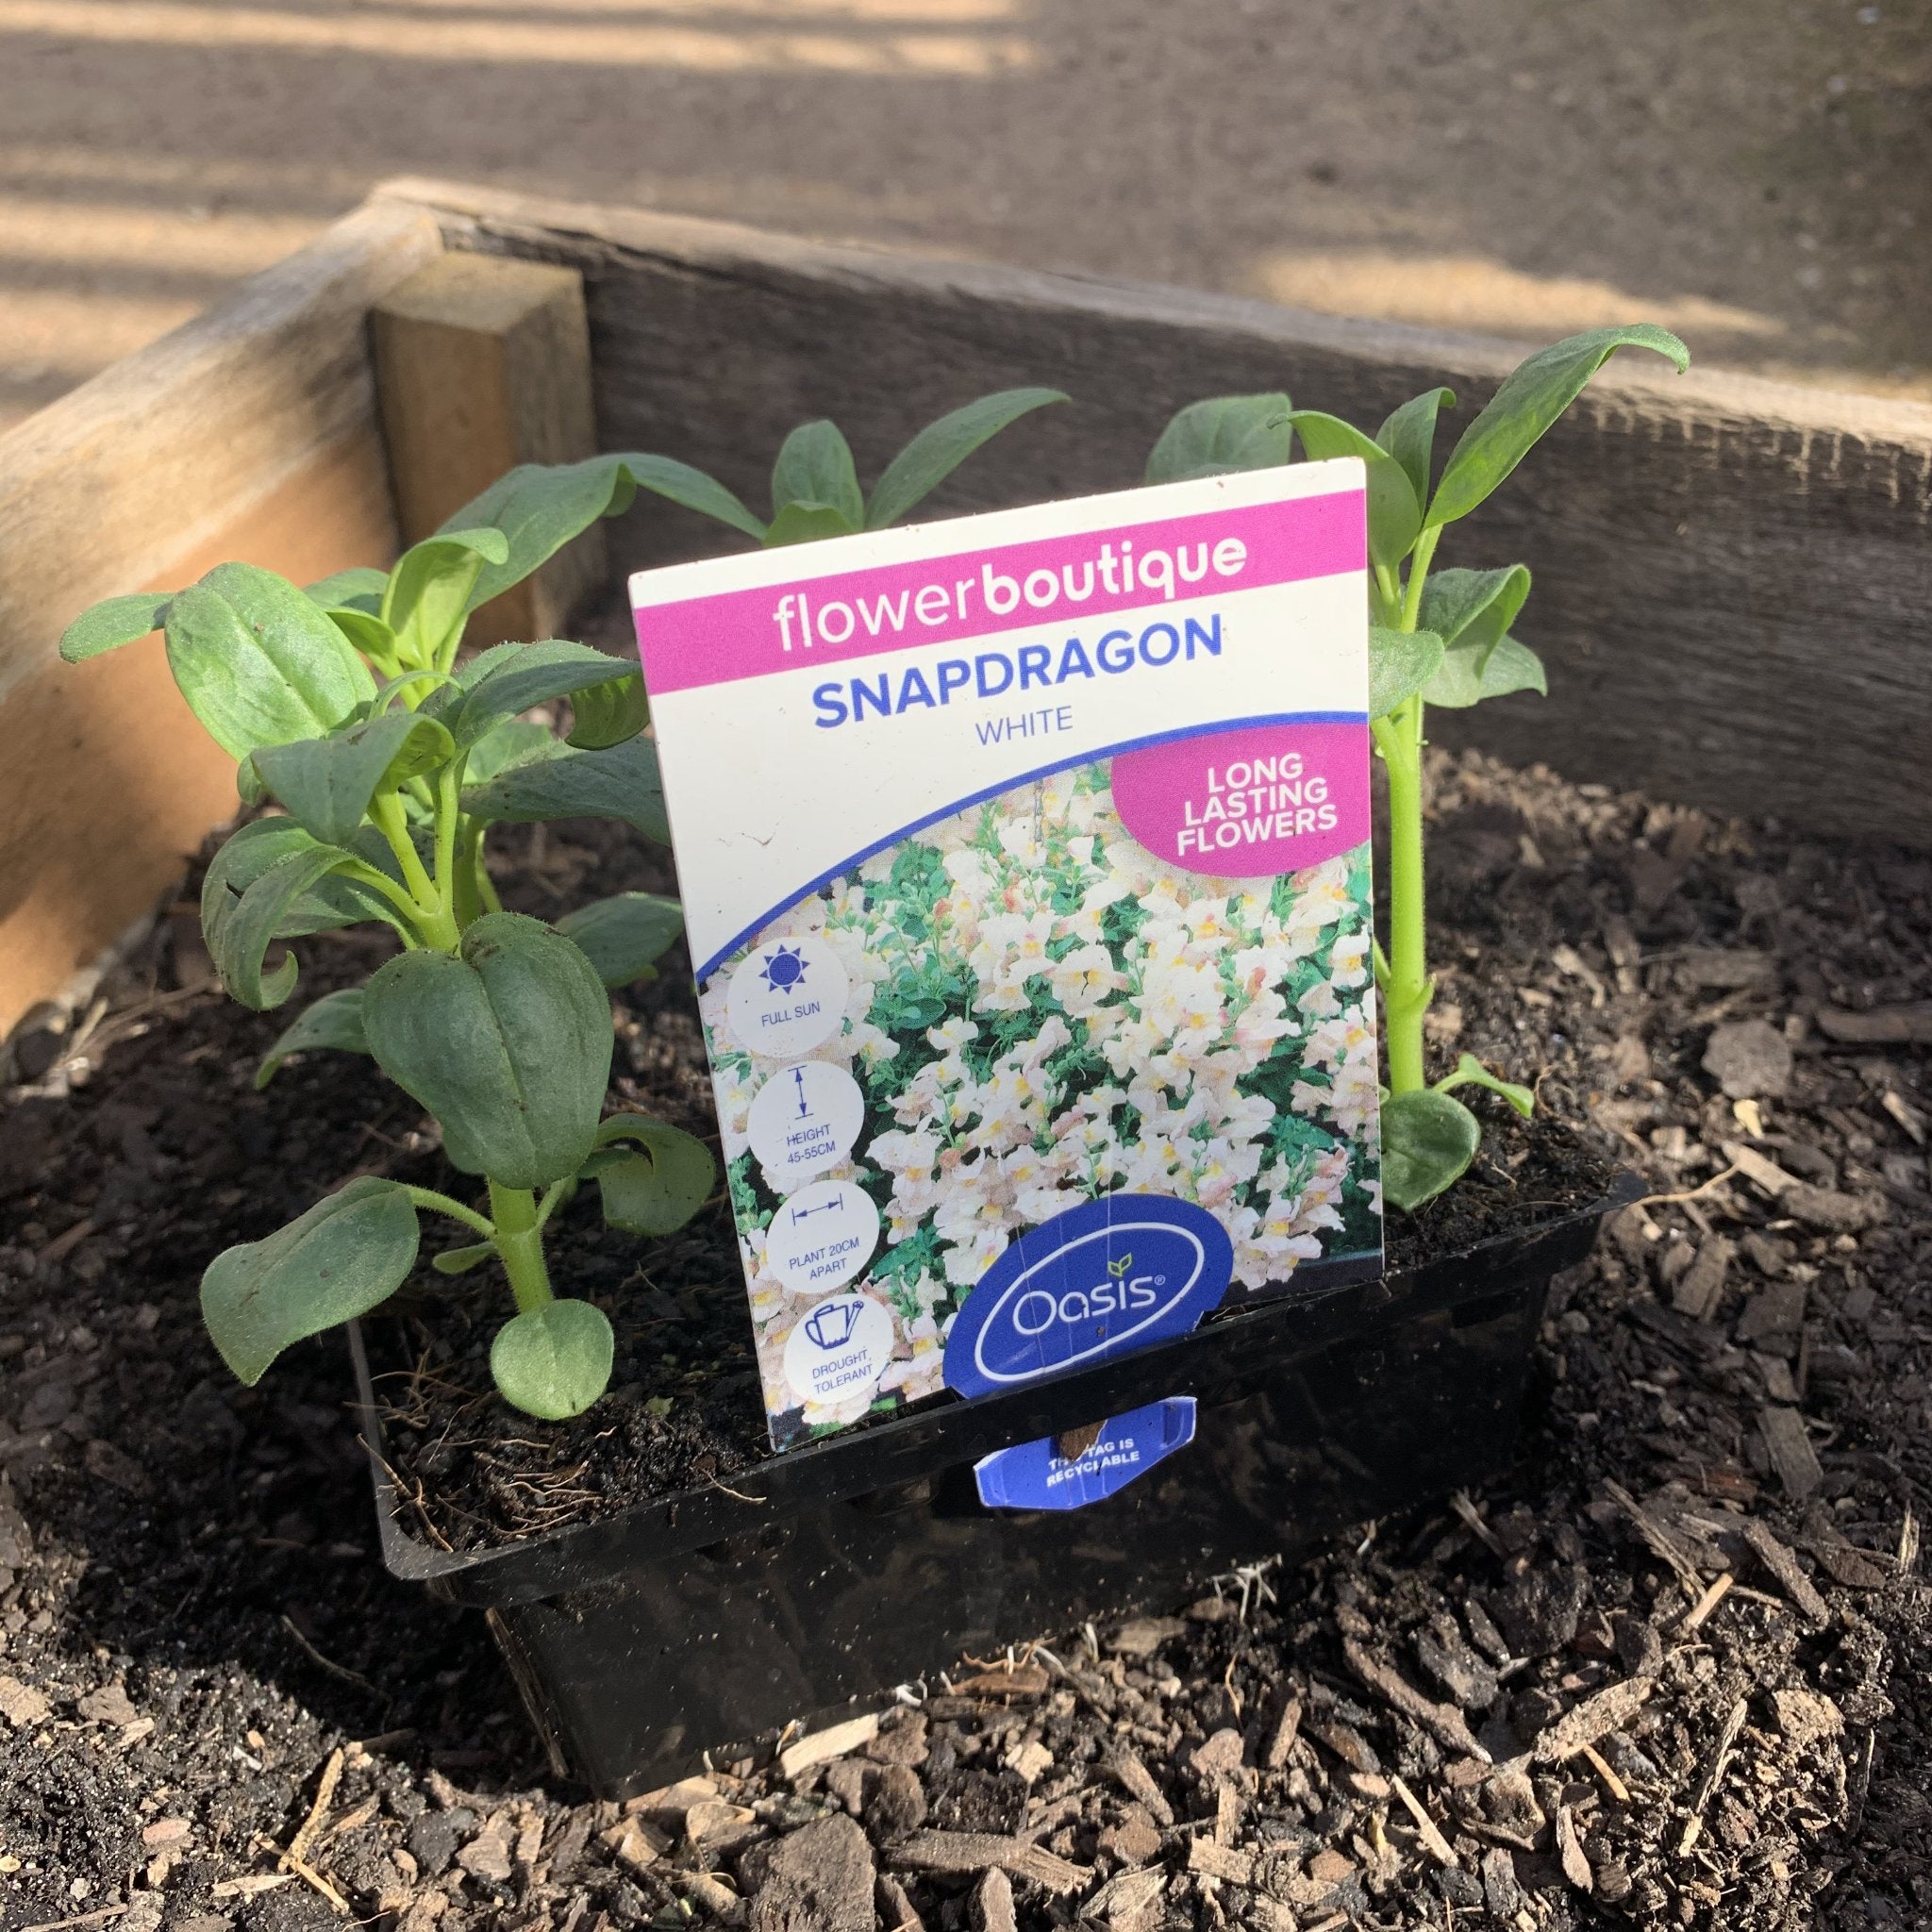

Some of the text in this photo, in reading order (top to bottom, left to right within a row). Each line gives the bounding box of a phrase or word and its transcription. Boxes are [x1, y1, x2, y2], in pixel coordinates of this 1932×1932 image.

[812, 613, 1224, 728] SNAPDRAGON
[975, 707, 1074, 746] WHITE
[1208, 753, 1303, 793] LONG
[1185, 777, 1327, 826] LASTING
[1177, 804, 1338, 857] FLOWERS
[761, 1001, 821, 1027] FULL SUN
[787, 1124, 831, 1146] HEIGHT
[787, 1141, 836, 1164] 45-55CM
[789, 1237, 859, 1270] PLANT 20CM
[809, 1257, 847, 1281] APART
[811, 1349, 869, 1379] DROUGHT
[814, 1364, 873, 1394] TOLERANT
[1088, 1441, 1115, 1457] TAG
[1120, 1438, 1135, 1450] IS
[1046, 1450, 1141, 1487] RECYCLABLE
